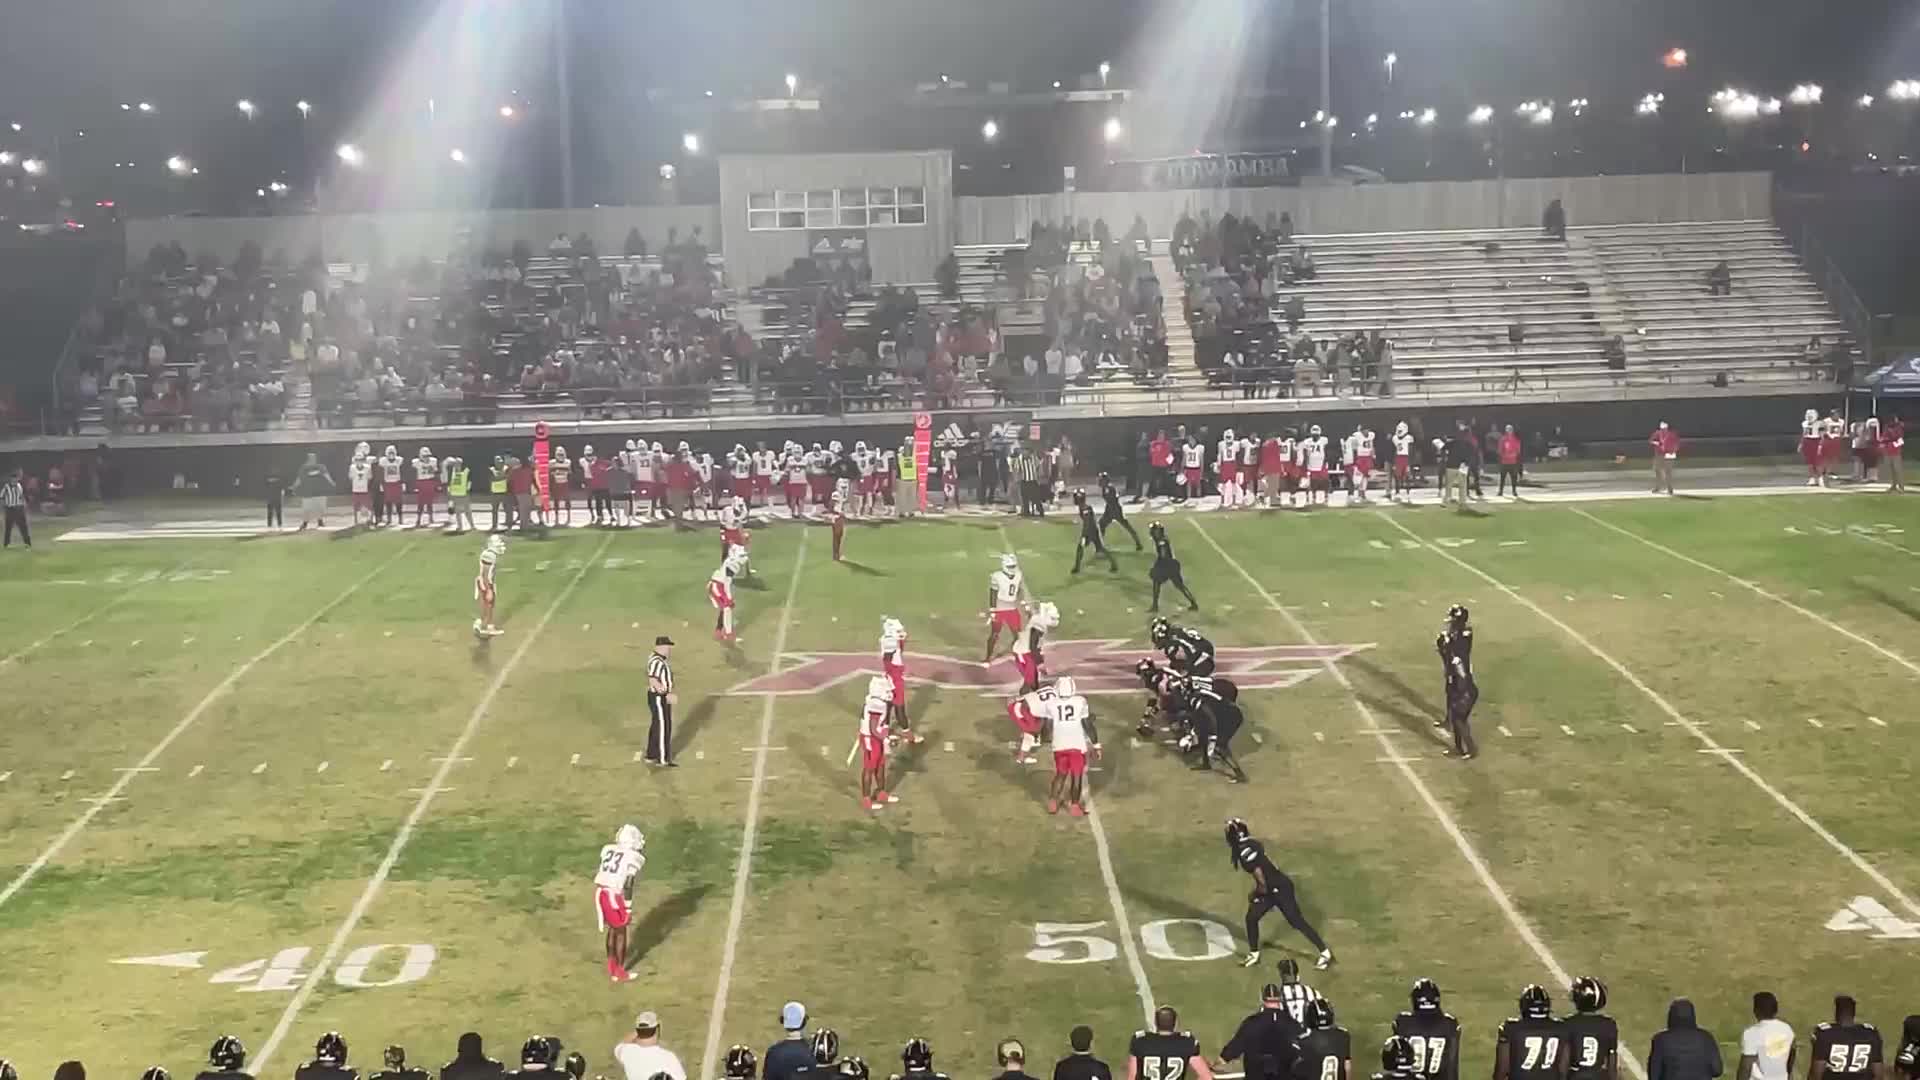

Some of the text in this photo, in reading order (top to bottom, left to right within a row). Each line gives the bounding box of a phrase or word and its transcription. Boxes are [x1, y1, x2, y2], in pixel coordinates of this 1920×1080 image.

[1057, 705, 1074, 721] 12
[602, 850, 624, 873] 23
[1024, 918, 1237, 964] 50
[207, 943, 436, 993] 40
[1521, 1037, 1559, 1070] 71
[1579, 1037, 1598, 1067] 3
[1827, 1044, 1871, 1072] 55
[1143, 1056, 1184, 1080] 52
